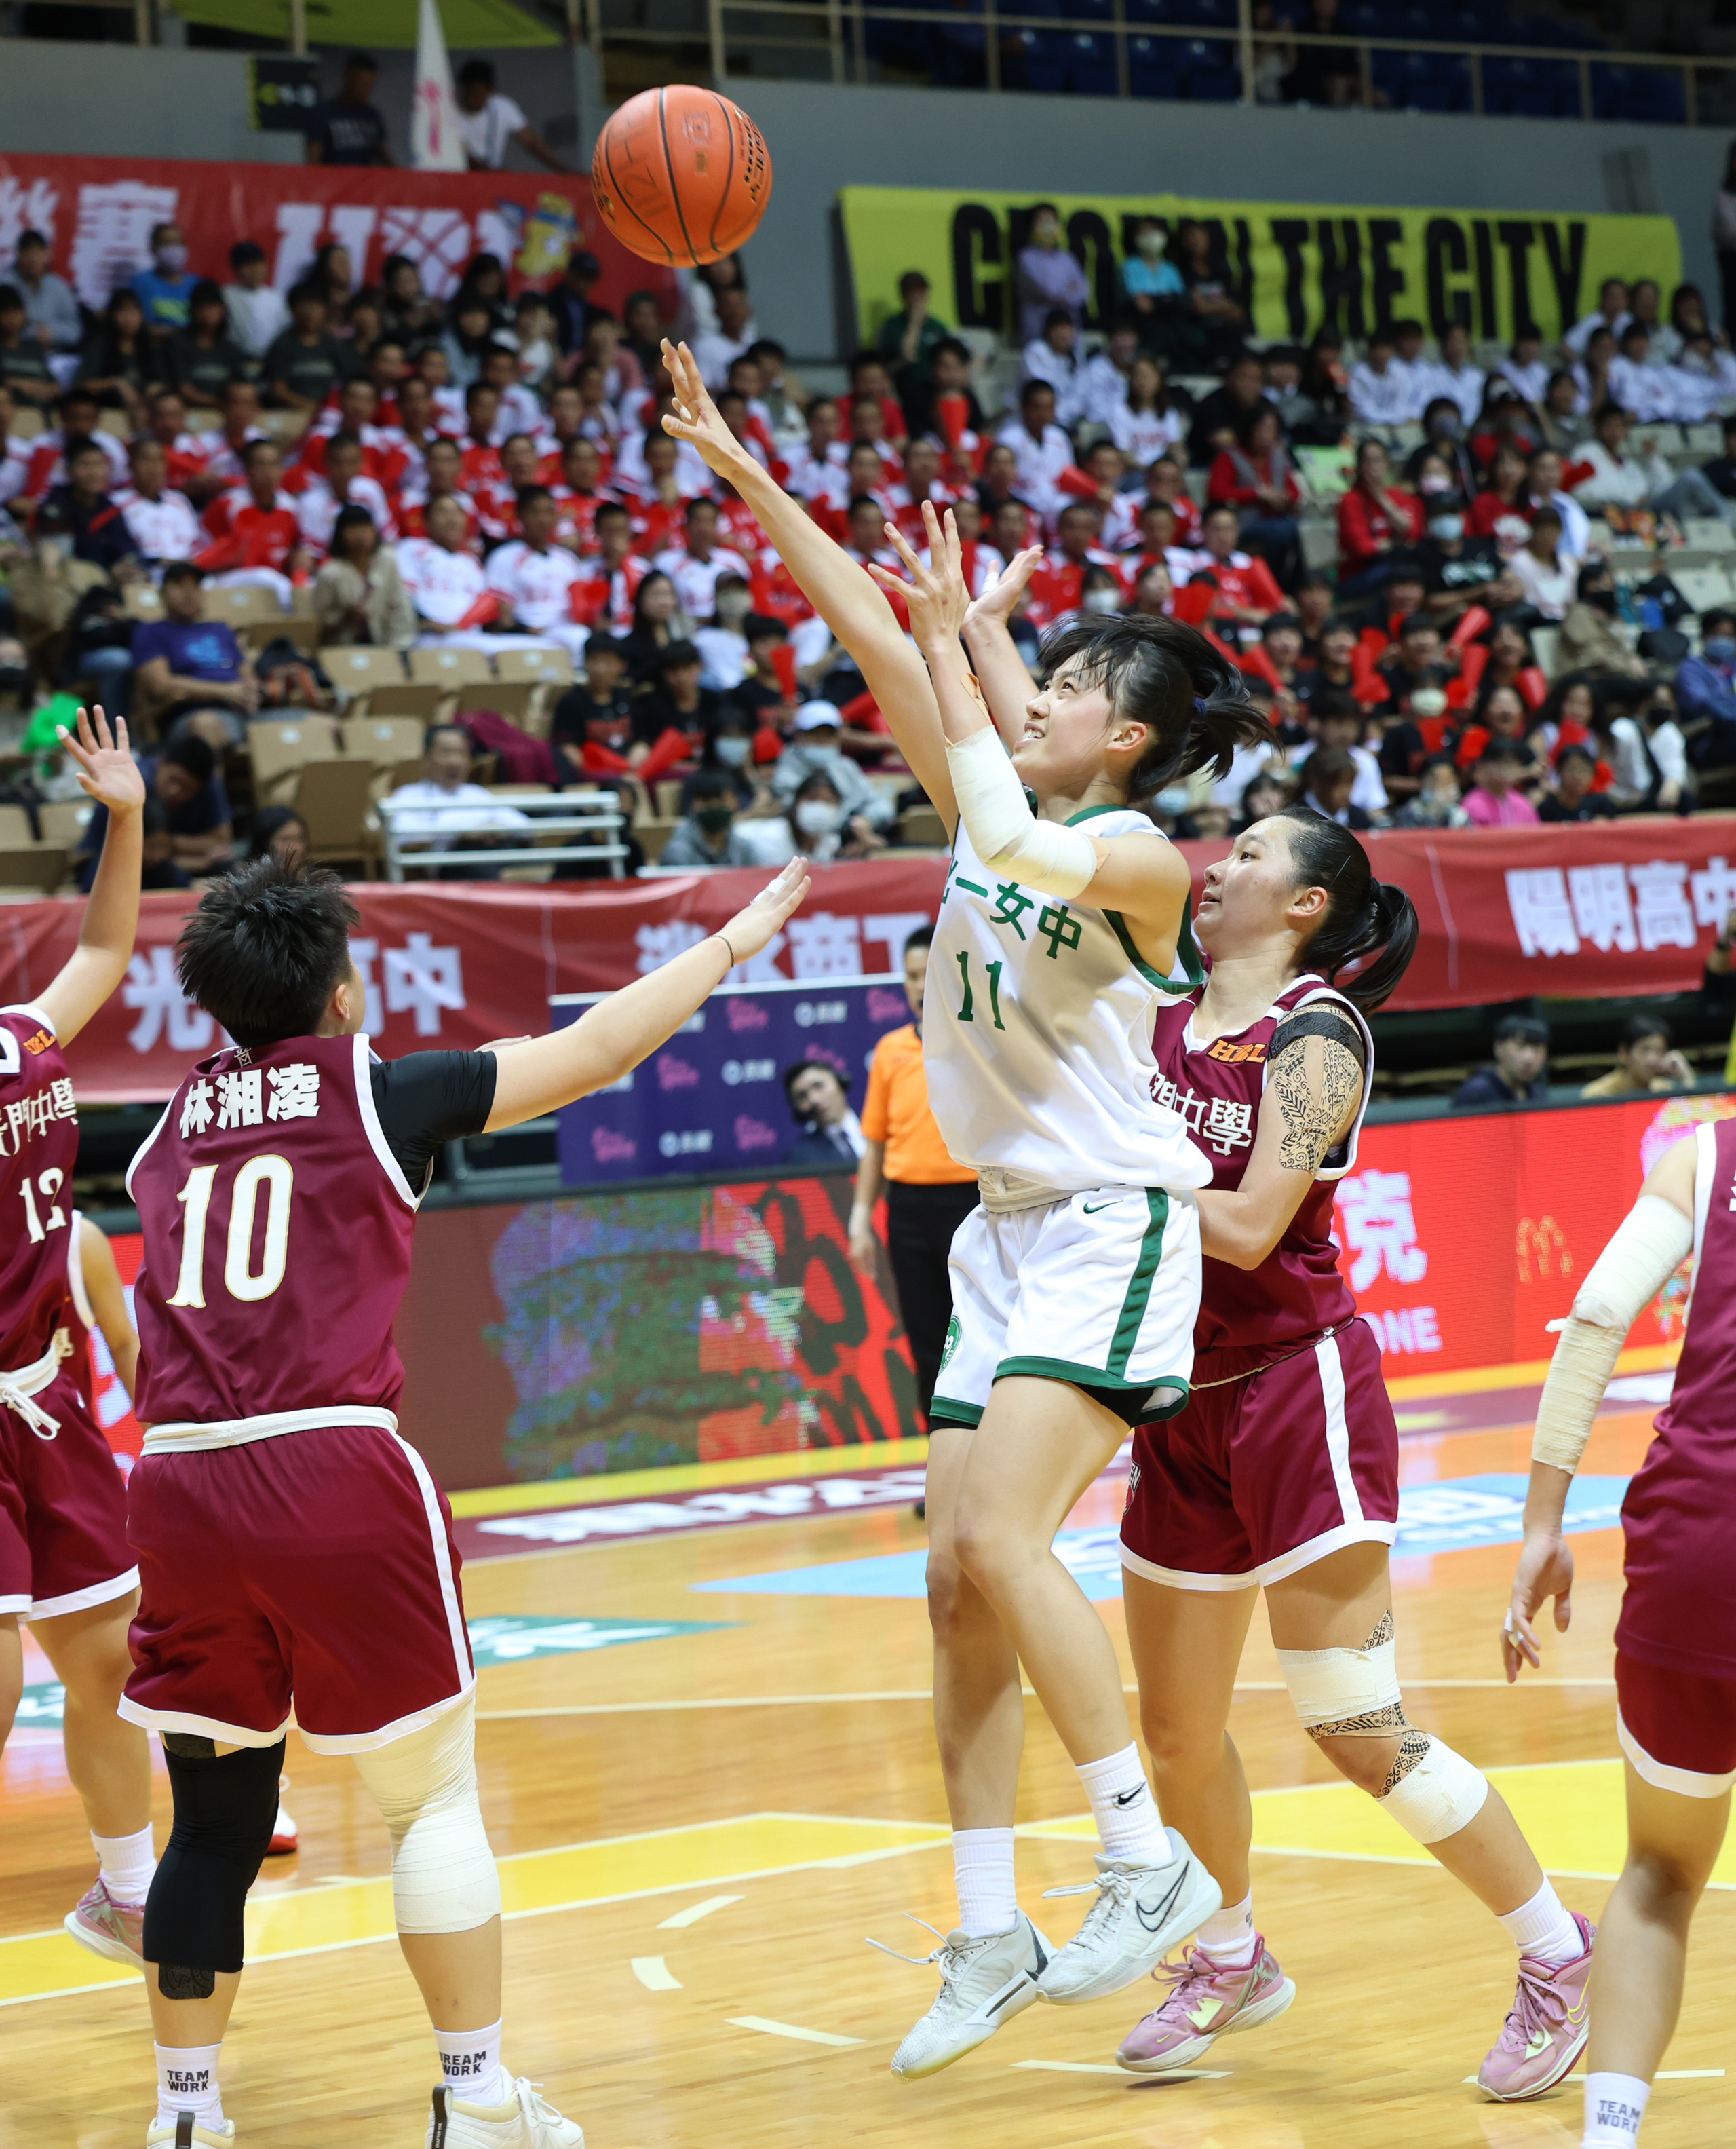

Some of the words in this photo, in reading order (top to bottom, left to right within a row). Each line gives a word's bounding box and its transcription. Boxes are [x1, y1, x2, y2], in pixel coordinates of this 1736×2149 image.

[1269, 217, 1406, 347] THE
[1426, 217, 1585, 347] CITY
[955, 950, 1006, 1031] 11
[0, 1076, 79, 1157] 門中學
[179, 1063, 321, 1140] 林湘凌
[18, 1166, 67, 1244] 12
[165, 1154, 294, 1309] 10
[167, 2069, 209, 2082] TEAM
[167, 2080, 209, 2093] WORK
[442, 2062, 482, 2076] WORK
[1599, 2099, 1640, 2121] TEAM
